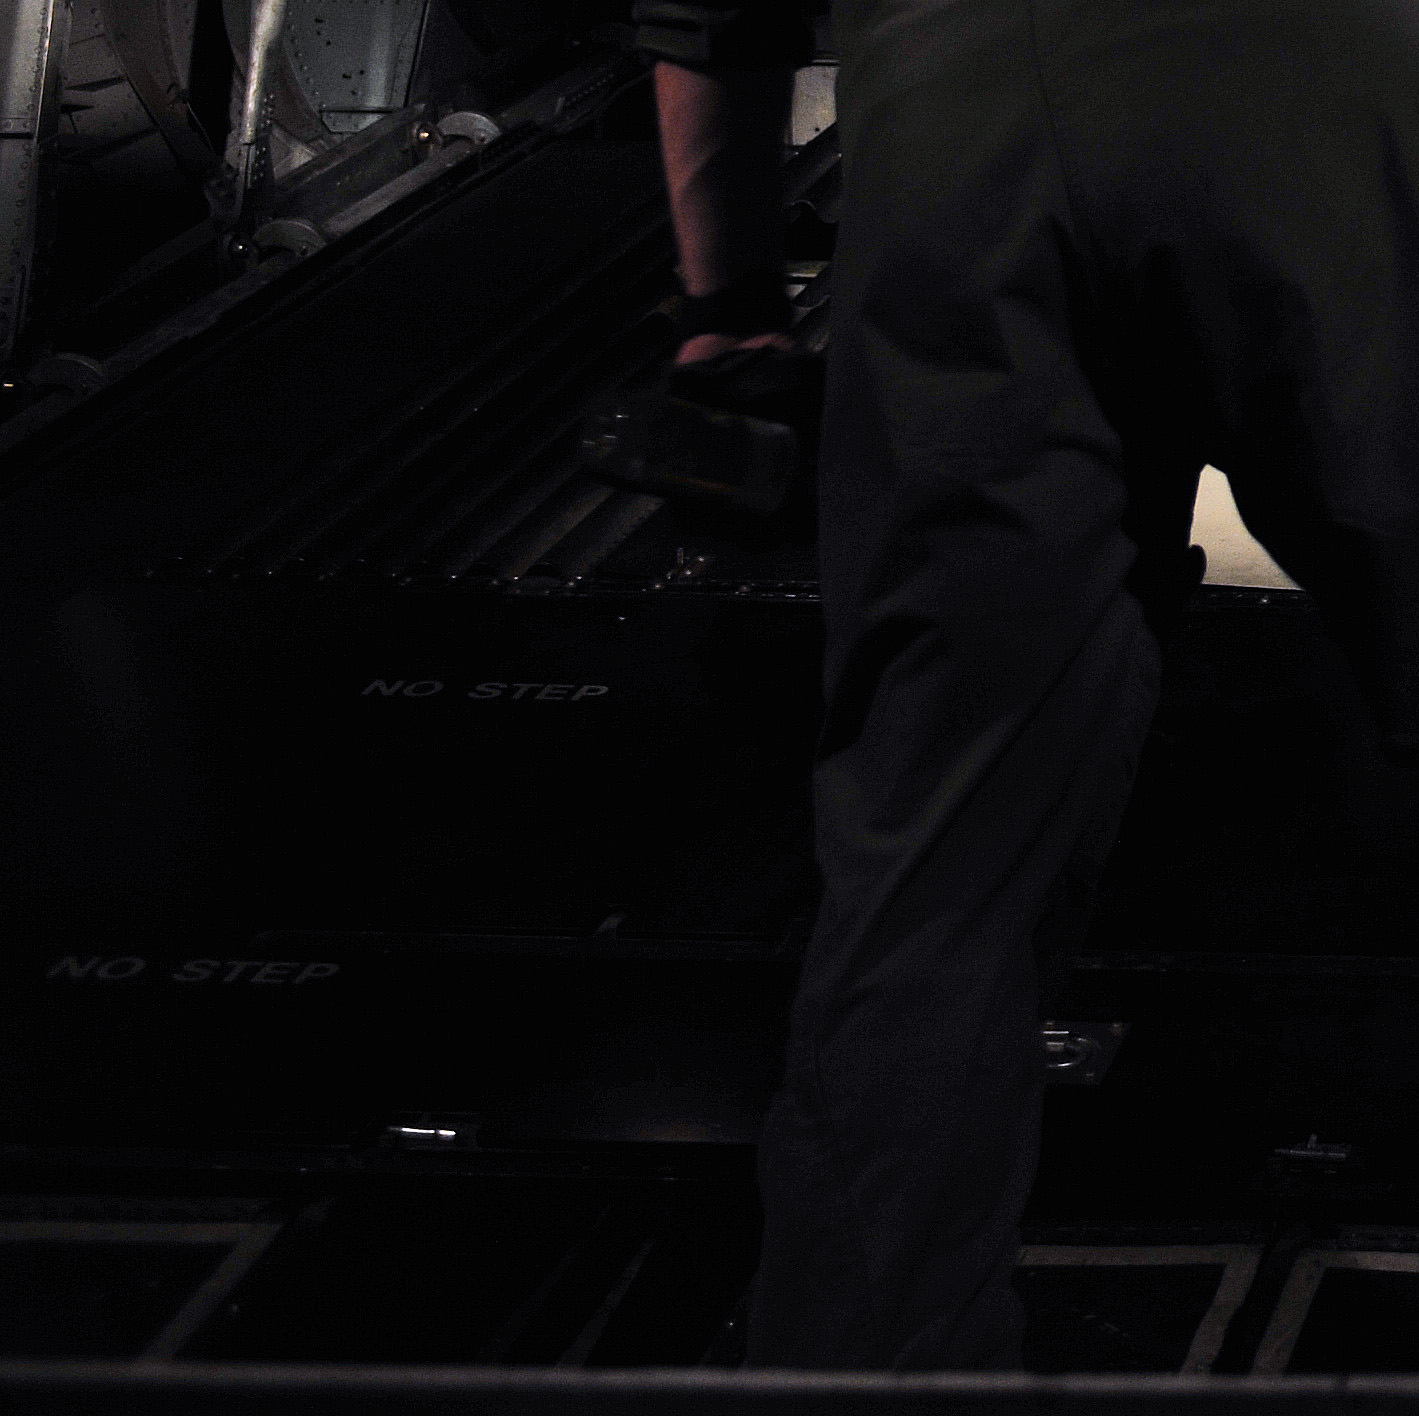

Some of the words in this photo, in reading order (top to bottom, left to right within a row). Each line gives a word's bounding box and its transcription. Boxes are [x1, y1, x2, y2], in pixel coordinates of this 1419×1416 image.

[359, 677, 446, 698] NO
[466, 681, 610, 702] STEP
[45, 956, 148, 981] NO
[171, 958, 342, 984] STEP
